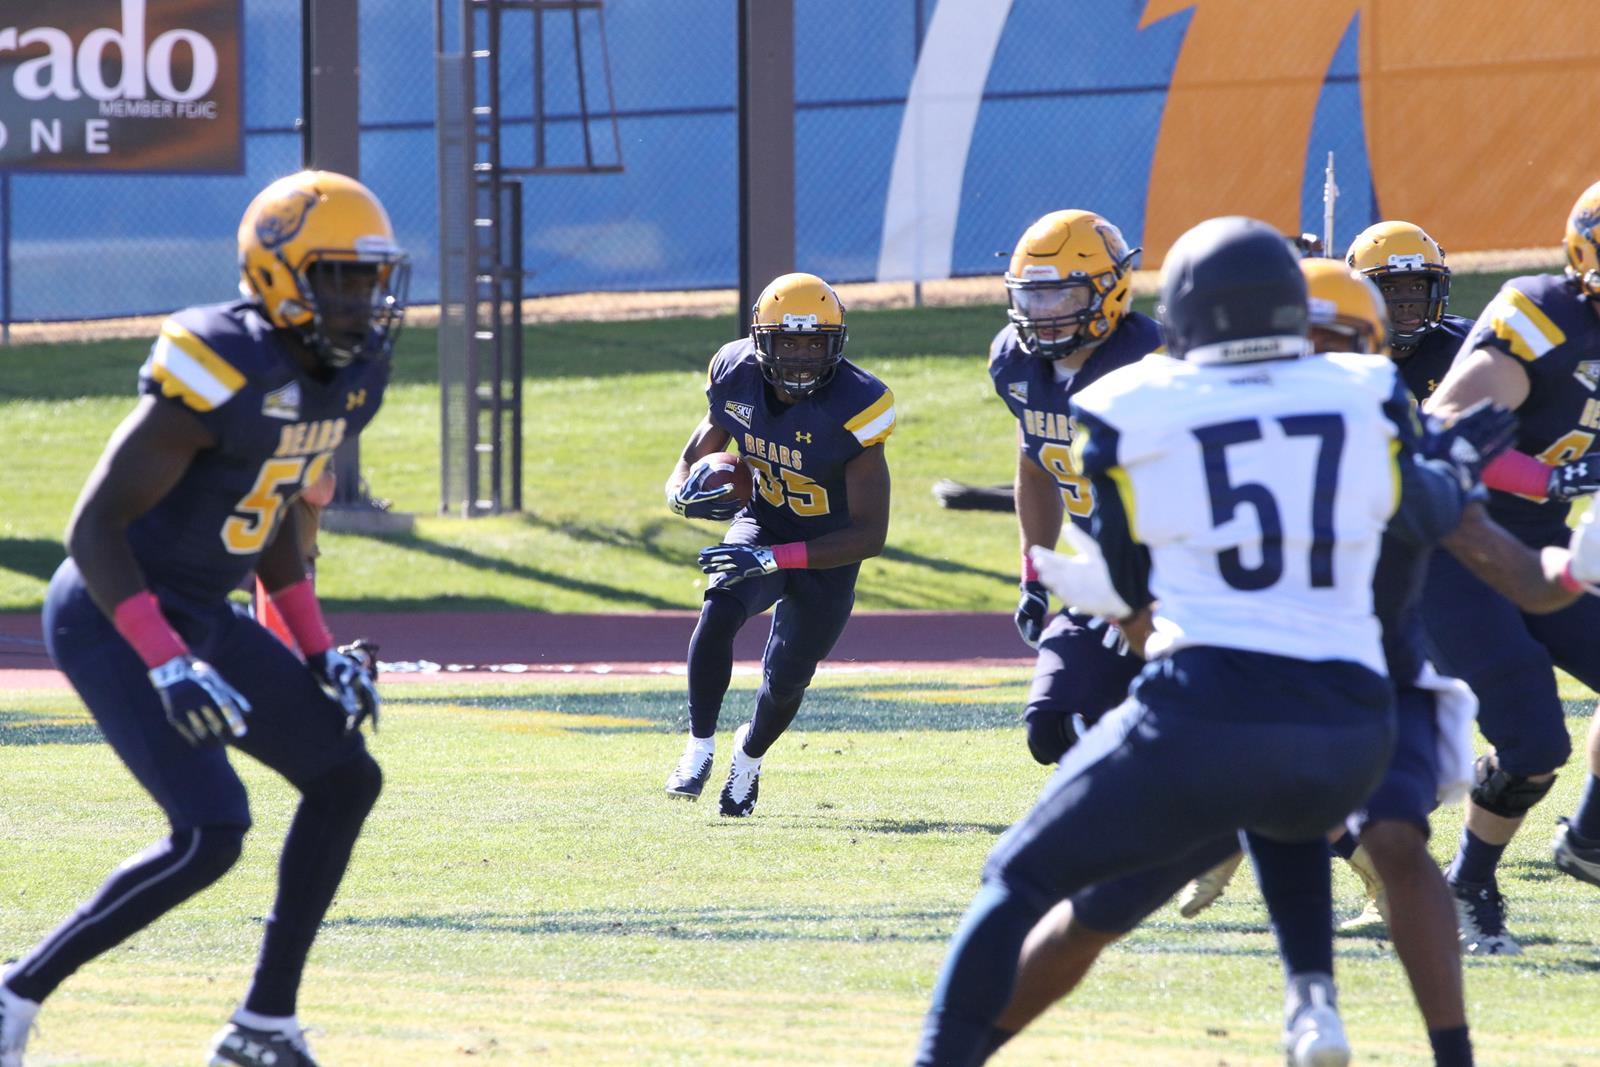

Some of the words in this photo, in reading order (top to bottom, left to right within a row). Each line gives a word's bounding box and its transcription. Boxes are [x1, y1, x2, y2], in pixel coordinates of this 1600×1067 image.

[99, 101, 173, 118] MEMBER
[177, 102, 217, 119] FDIC
[0, 118, 111, 154] NE
[273, 418, 347, 457] BEARS
[744, 432, 802, 470] BEARS
[220, 453, 333, 555] 5
[744, 455, 831, 517] 35
[1190, 412, 1347, 593] 57
